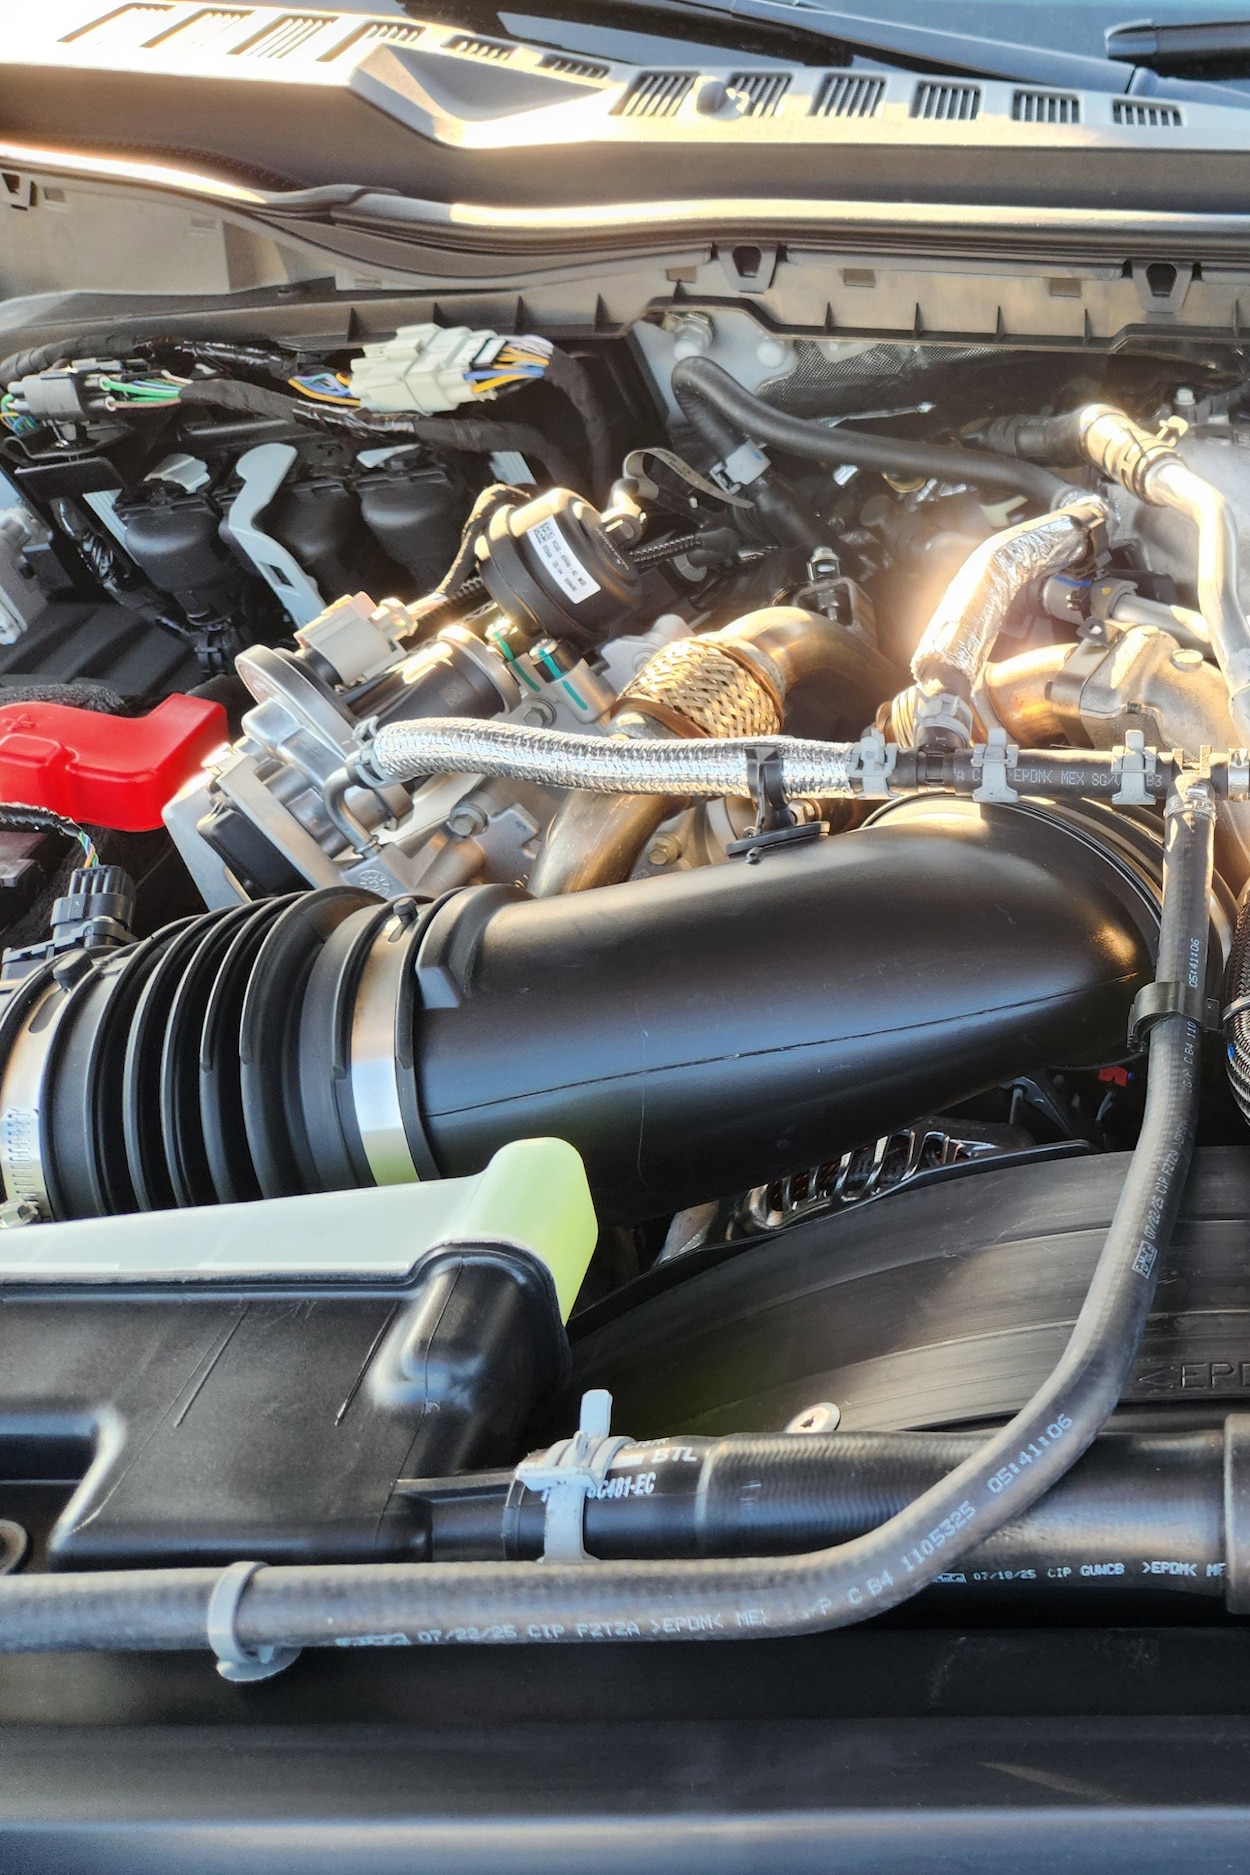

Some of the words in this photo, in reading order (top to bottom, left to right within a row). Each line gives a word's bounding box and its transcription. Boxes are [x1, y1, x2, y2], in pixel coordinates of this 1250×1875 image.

[1061, 771, 1085, 785] MEX
[1188, 937, 1200, 989] 05:41:06
[651, 1446, 698, 1465] BTL
[526, 1623, 564, 1639] CIP
[573, 1621, 640, 1639] F2T2A
[649, 1612, 725, 1635] >EPDM<
[847, 1587, 863, 1606] C
[866, 1570, 895, 1598] B4
[902, 1500, 977, 1573] 1105325
[986, 1413, 1074, 1495] 05:41:06
[1047, 1567, 1073, 1579] CIP
[1142, 1560, 1198, 1577] >EPDM<
